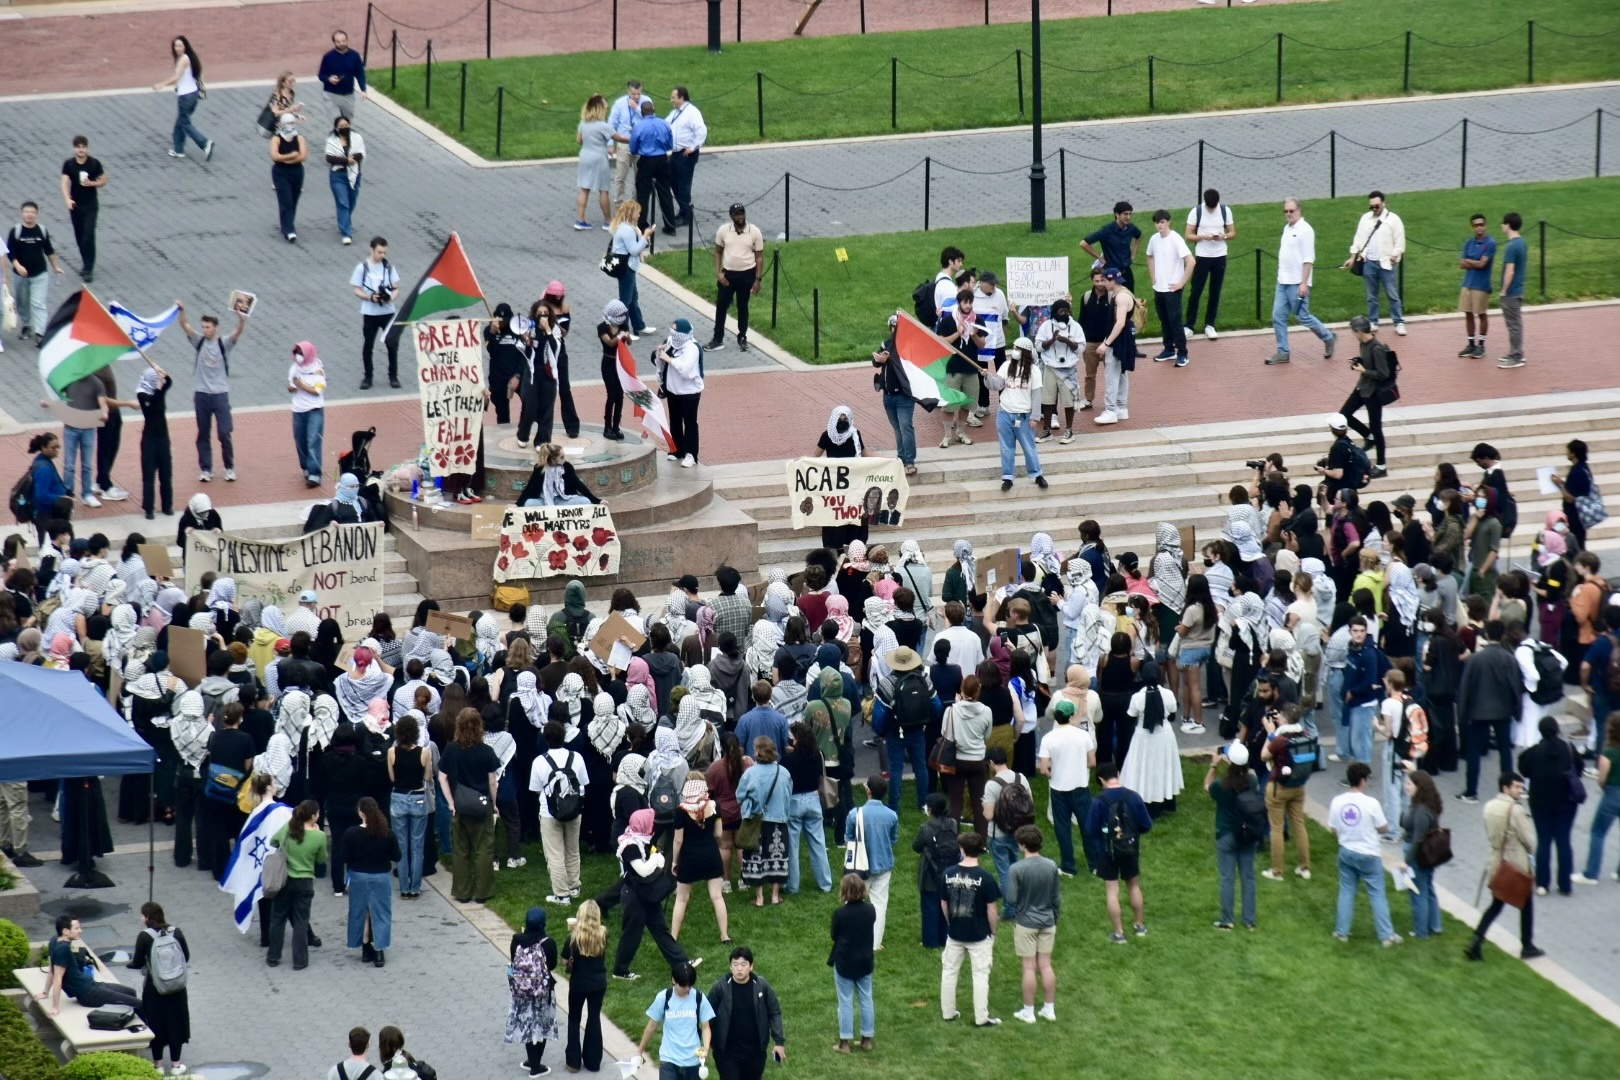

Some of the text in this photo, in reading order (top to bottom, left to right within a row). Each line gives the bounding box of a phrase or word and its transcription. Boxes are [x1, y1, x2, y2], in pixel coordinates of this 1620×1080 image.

[1010, 260, 1061, 271] HEZBOLLAH
[1008, 272, 1035, 281] IS NOT
[418, 320, 480, 352] BREAK
[438, 351, 459, 365] THE
[421, 365, 479, 385] CHAINS
[443, 384, 462, 396] AND
[426, 396, 483, 419] LET THEM
[437, 417, 473, 445] FALL
[795, 466, 895, 493] ACAB means
[821, 496, 846, 507] YOU
[524, 511, 549, 524] WILL
[557, 508, 584, 518] HONOR
[591, 507, 608, 519] ALL
[832, 505, 864, 521] TWO!
[522, 520, 591, 534] OUR MARTYRS
[217, 538, 289, 574] PALESTINE
[286, 547, 298, 558] to
[301, 526, 377, 568] LEBANON
[287, 580, 303, 595] do
[313, 571, 348, 591] NOT
[349, 568, 378, 585] bend
